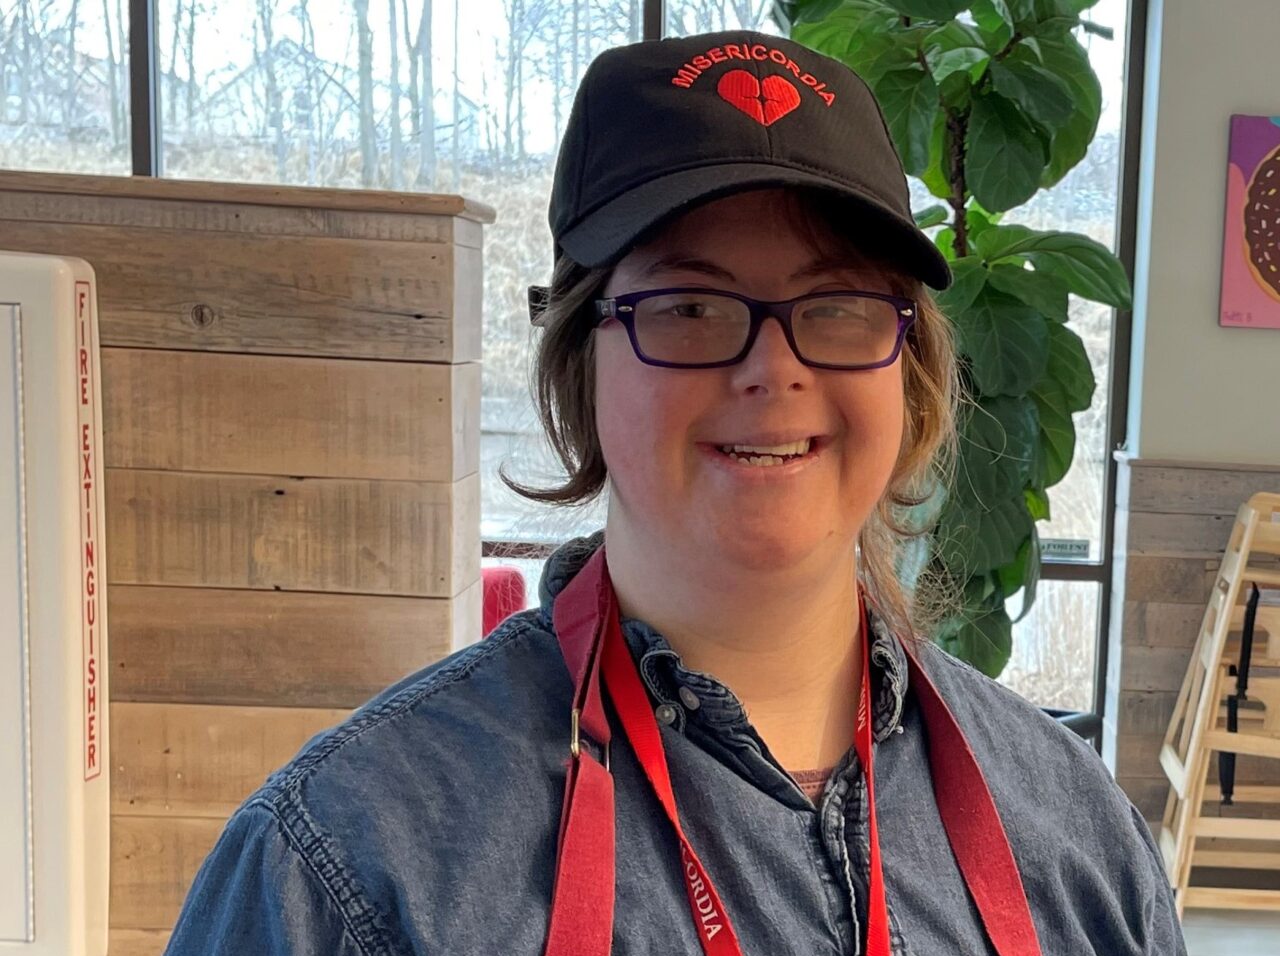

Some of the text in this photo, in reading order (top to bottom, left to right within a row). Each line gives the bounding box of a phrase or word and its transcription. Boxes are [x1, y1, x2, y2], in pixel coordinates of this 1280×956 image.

[672, 44, 836, 107] MISERICORDIA
[79, 291, 96, 769] FIRE EXTINGUISHER
